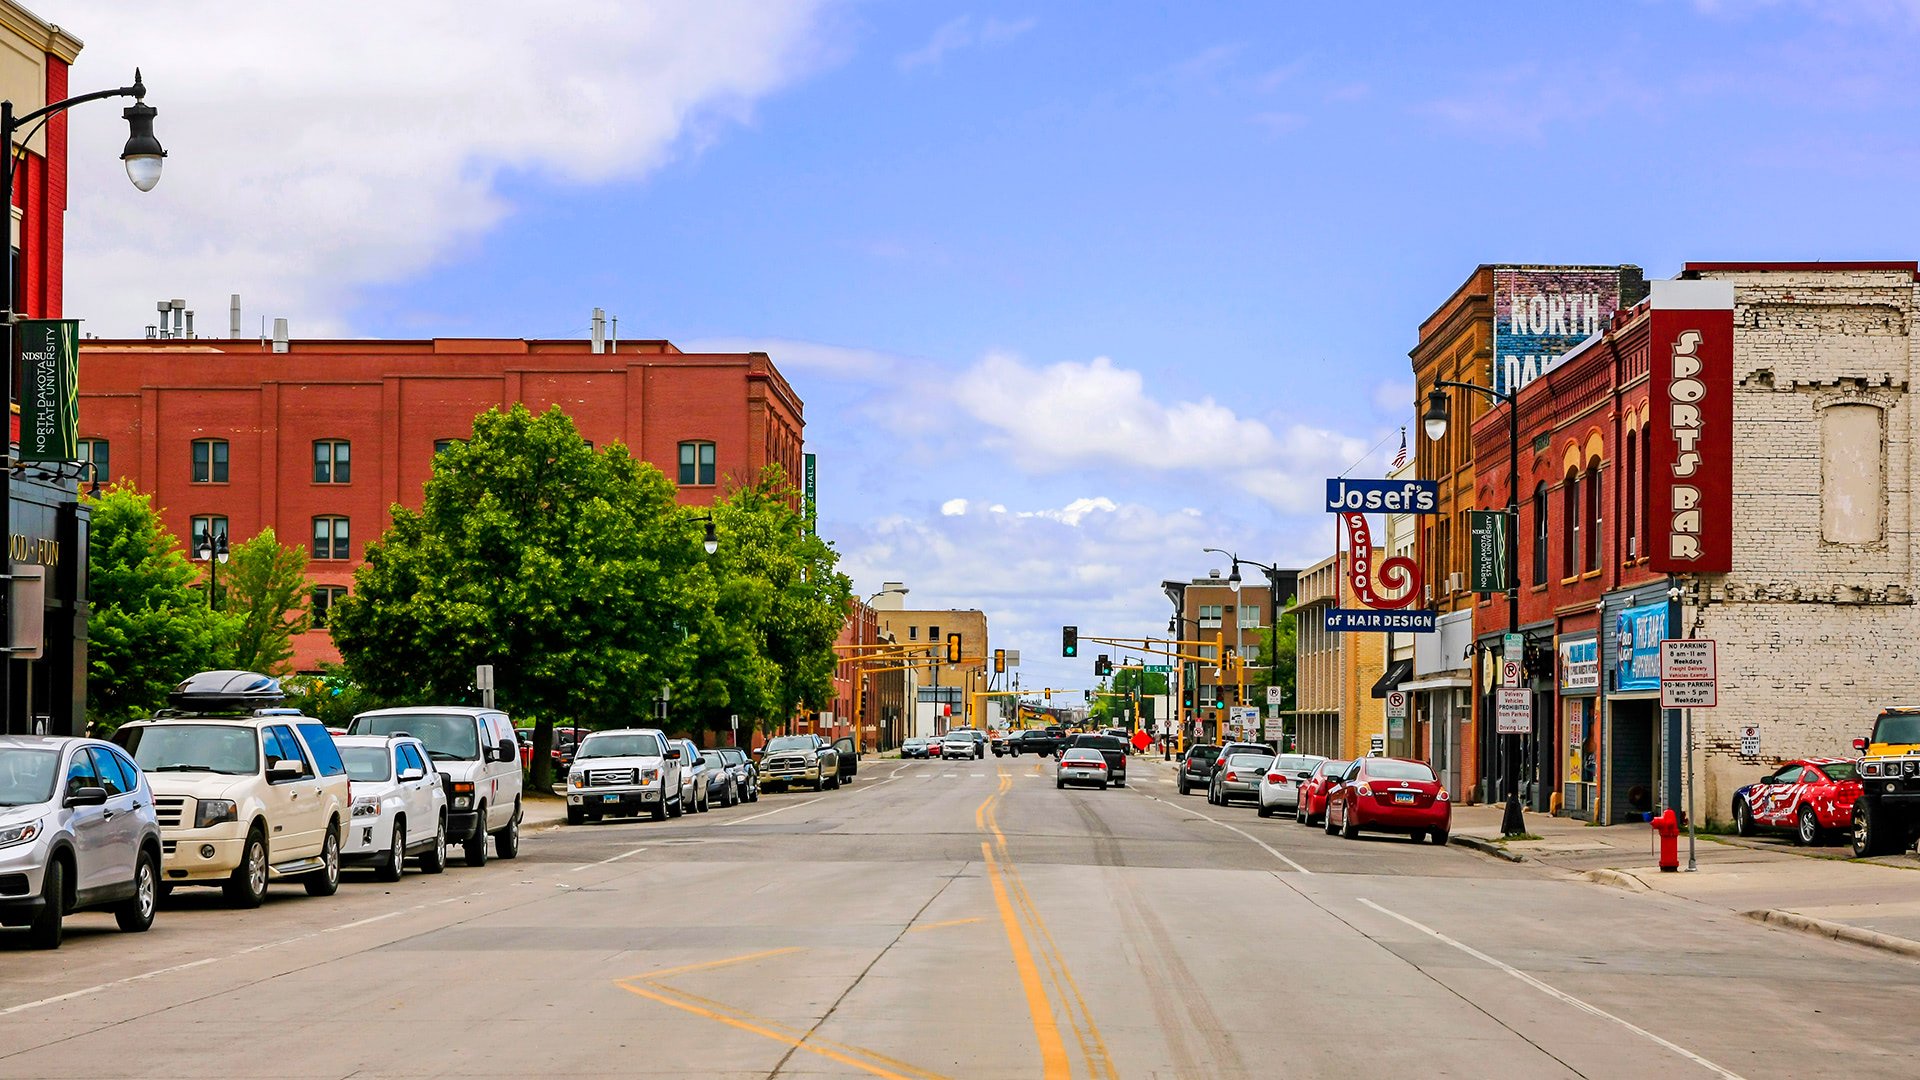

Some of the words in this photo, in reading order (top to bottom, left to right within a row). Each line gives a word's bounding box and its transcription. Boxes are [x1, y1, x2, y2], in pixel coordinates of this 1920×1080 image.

[1511, 294, 1599, 335] NORTH
[22, 352, 46, 360] NDSU
[46, 327, 54, 395] UNIVERSITY
[37, 361, 46, 408] DAKOTA
[46, 400, 54, 434] STATE
[1668, 330, 1706, 478] SPORTS
[37, 412, 46, 452] NORTH
[1330, 482, 1434, 510] Josef's
[1670, 484, 1705, 562] BAR
[38, 538, 59, 566] FUN
[1351, 516, 1373, 602] SCHOOL
[1328, 615, 1342, 626] of
[1347, 615, 1381, 627] HAIR
[1384, 615, 1432, 627] DESIGN
[1622, 632, 1632, 646] BUD
[1619, 647, 1633, 661] LIGHT
